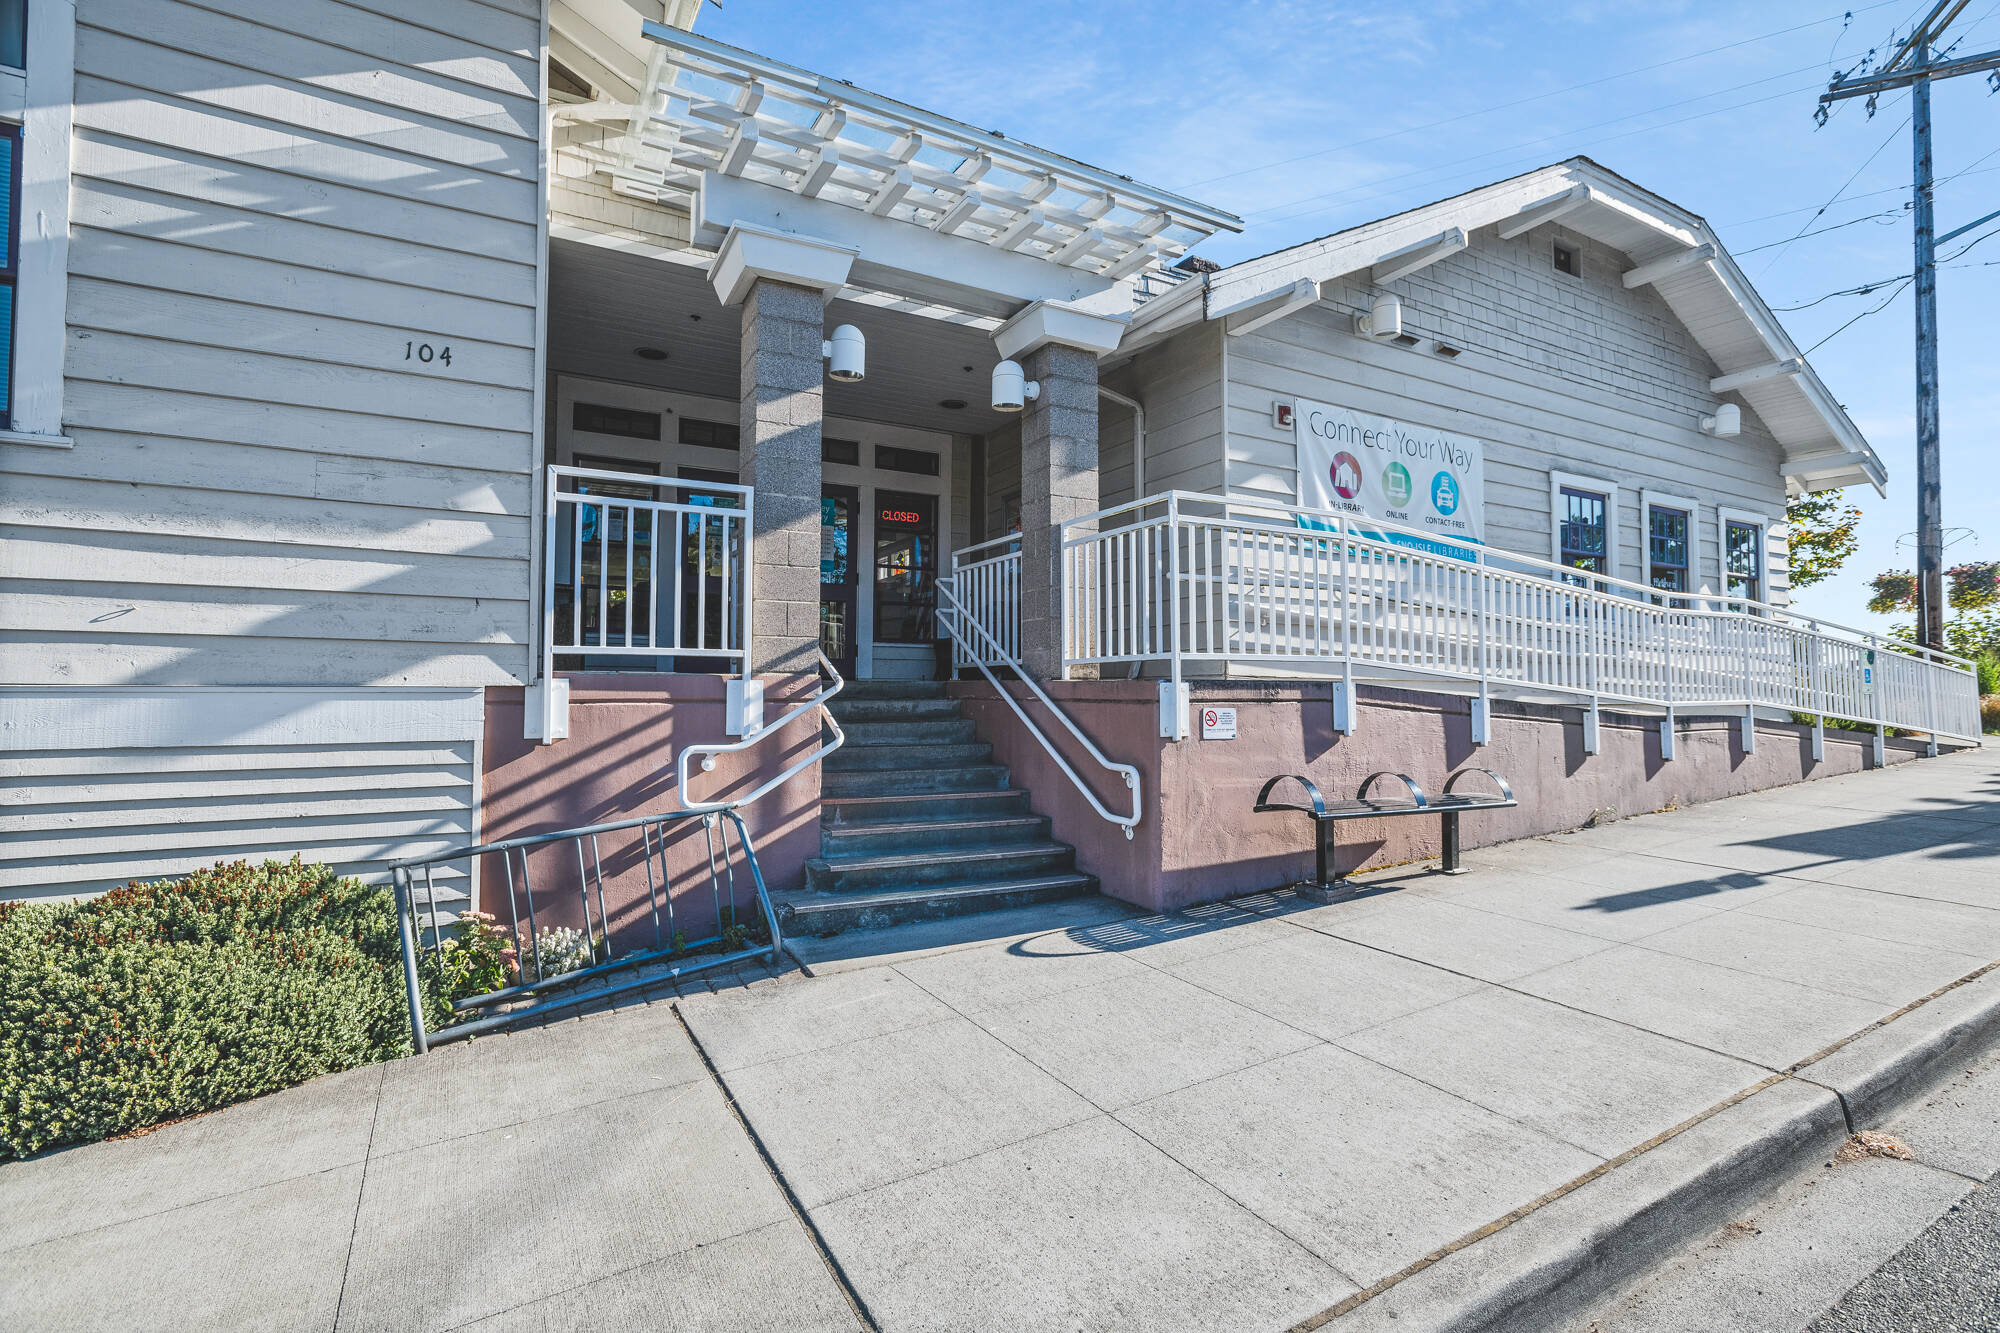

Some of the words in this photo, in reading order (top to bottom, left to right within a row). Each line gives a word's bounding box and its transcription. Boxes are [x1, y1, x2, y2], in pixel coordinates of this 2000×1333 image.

[405, 341, 452, 367] 104
[1309, 411, 1392, 452] Connect
[1394, 429, 1435, 460] Your
[1437, 439, 1473, 474] Way
[1328, 500, 1365, 512] IN-LIBRARY
[881, 510, 920, 523] CLOSED
[1385, 510, 1409, 521] ONLINE
[1425, 516, 1465, 529] CONTACT-FREE
